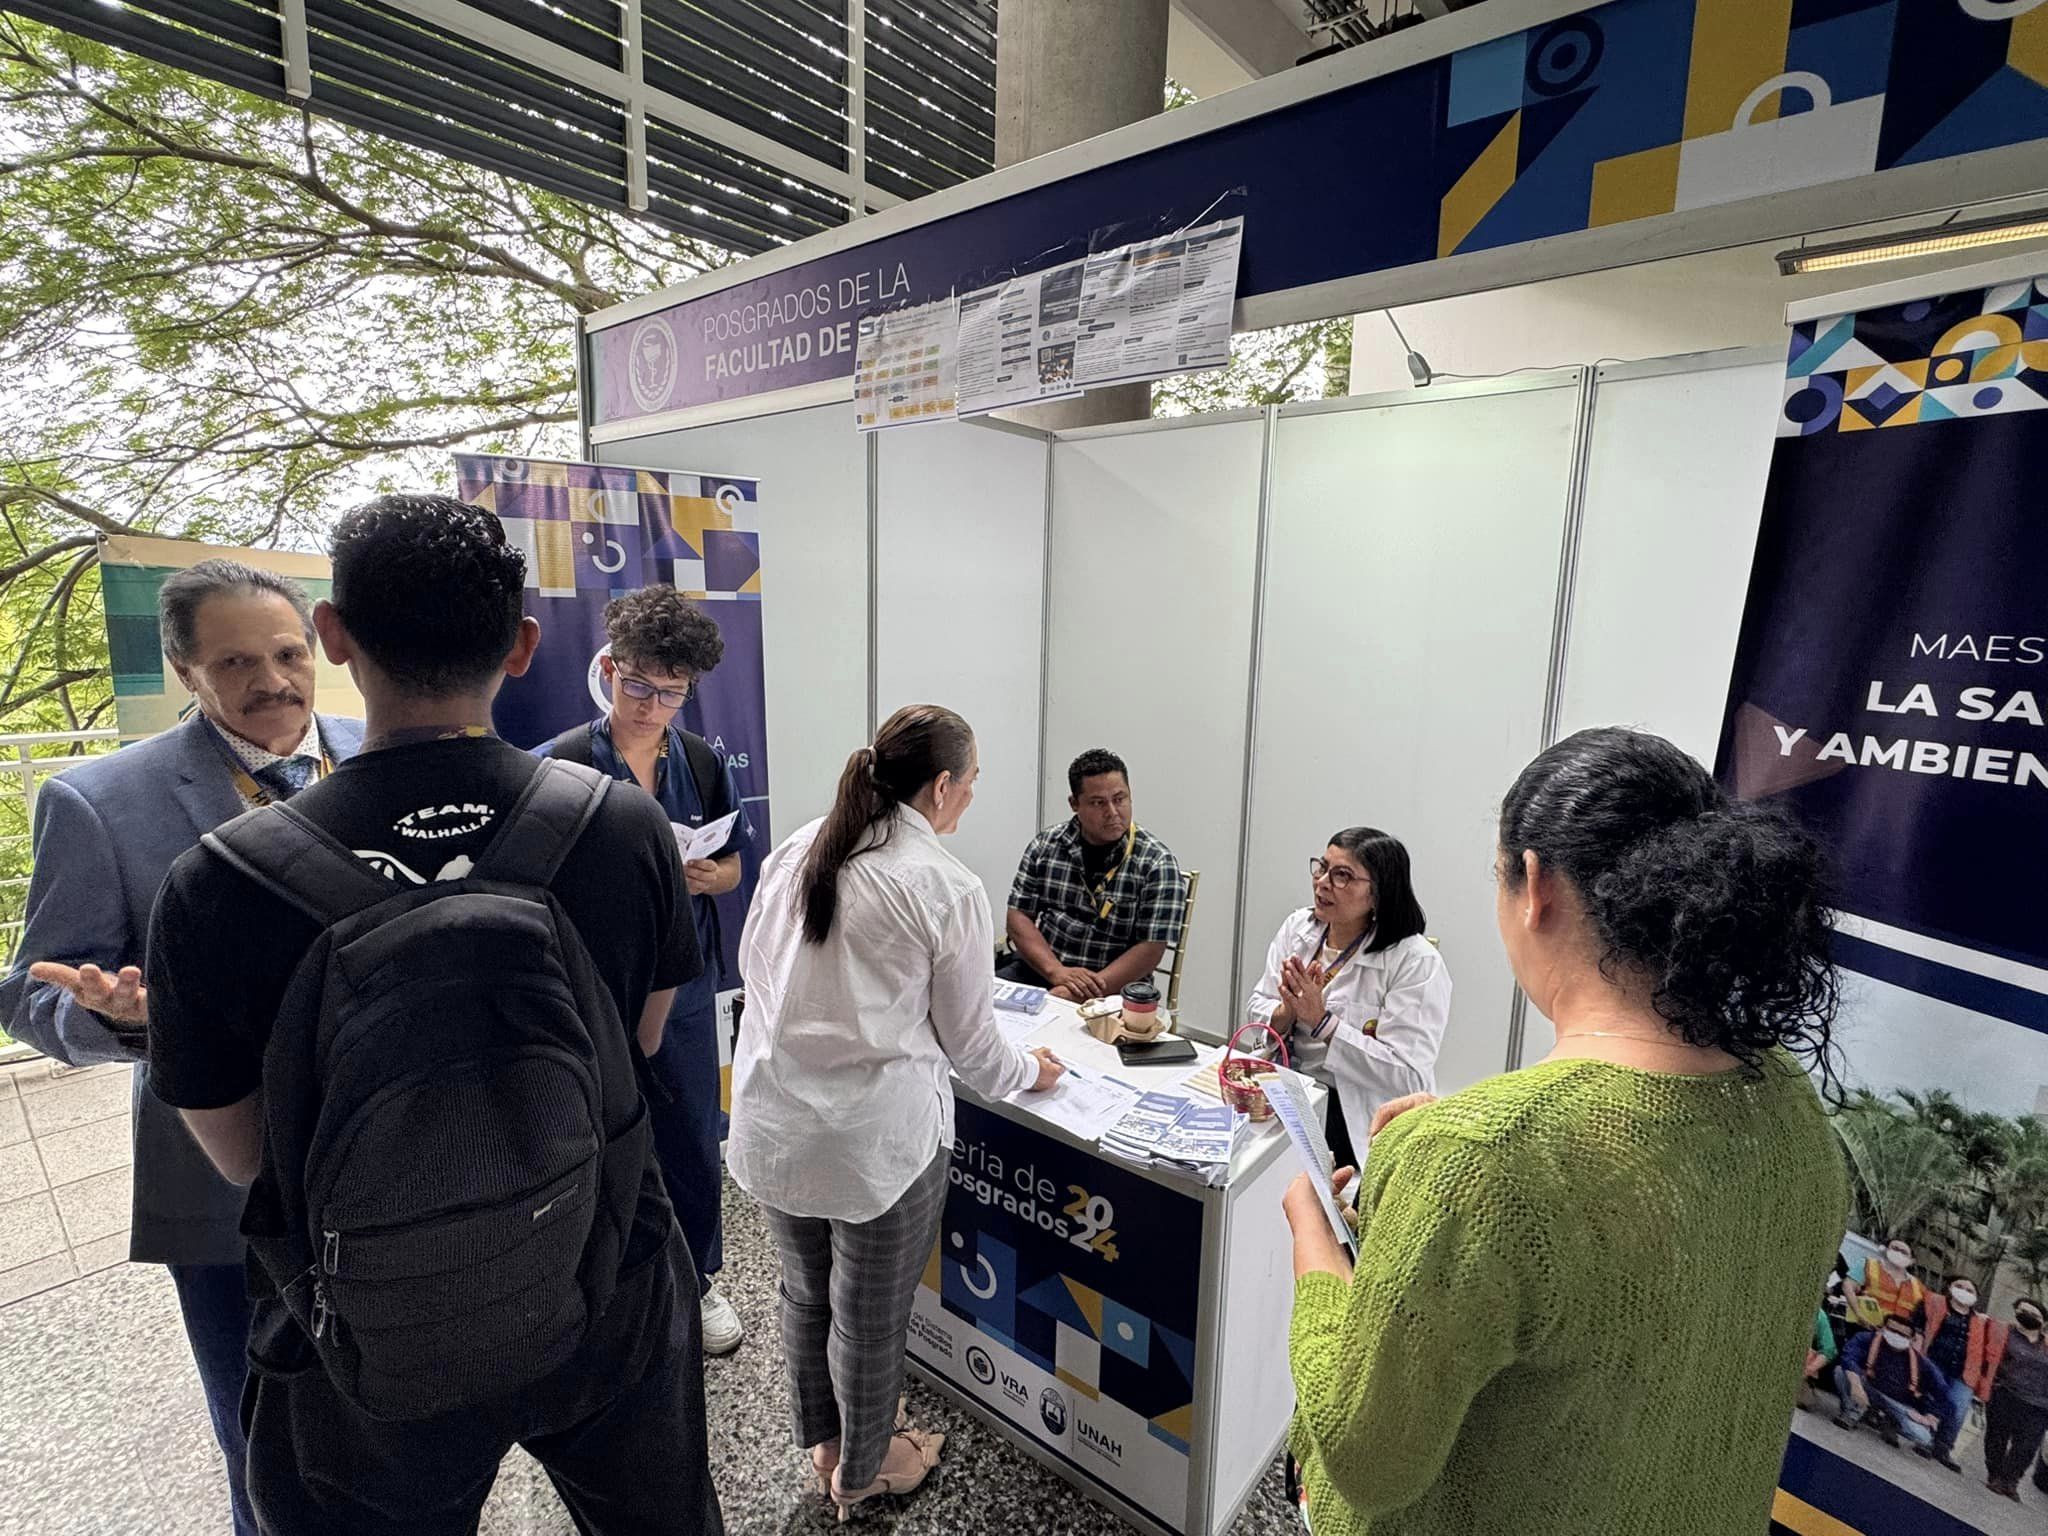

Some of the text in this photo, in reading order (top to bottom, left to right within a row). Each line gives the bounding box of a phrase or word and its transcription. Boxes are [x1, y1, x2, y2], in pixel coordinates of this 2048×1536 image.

[704, 284, 831, 344] POSGRADOS
[838, 272, 871, 309] DE
[879, 262, 912, 299] LA
[705, 332, 812, 381] FACULTAD
[819, 321, 852, 357] DE
[1910, 633, 2046, 664] MAES
[1866, 680, 2045, 726] LA SA
[727, 753, 750, 769] AS
[1773, 726, 2048, 788] Y AMBIEN
[397, 803, 489, 827] TEAM
[402, 815, 492, 839] WALHALLA
[951, 1137, 1057, 1203] eria de
[949, 1166, 1069, 1239] osgrados
[1000, 1371, 1029, 1401] VRA
[1077, 1418, 1122, 1458] UNAH
